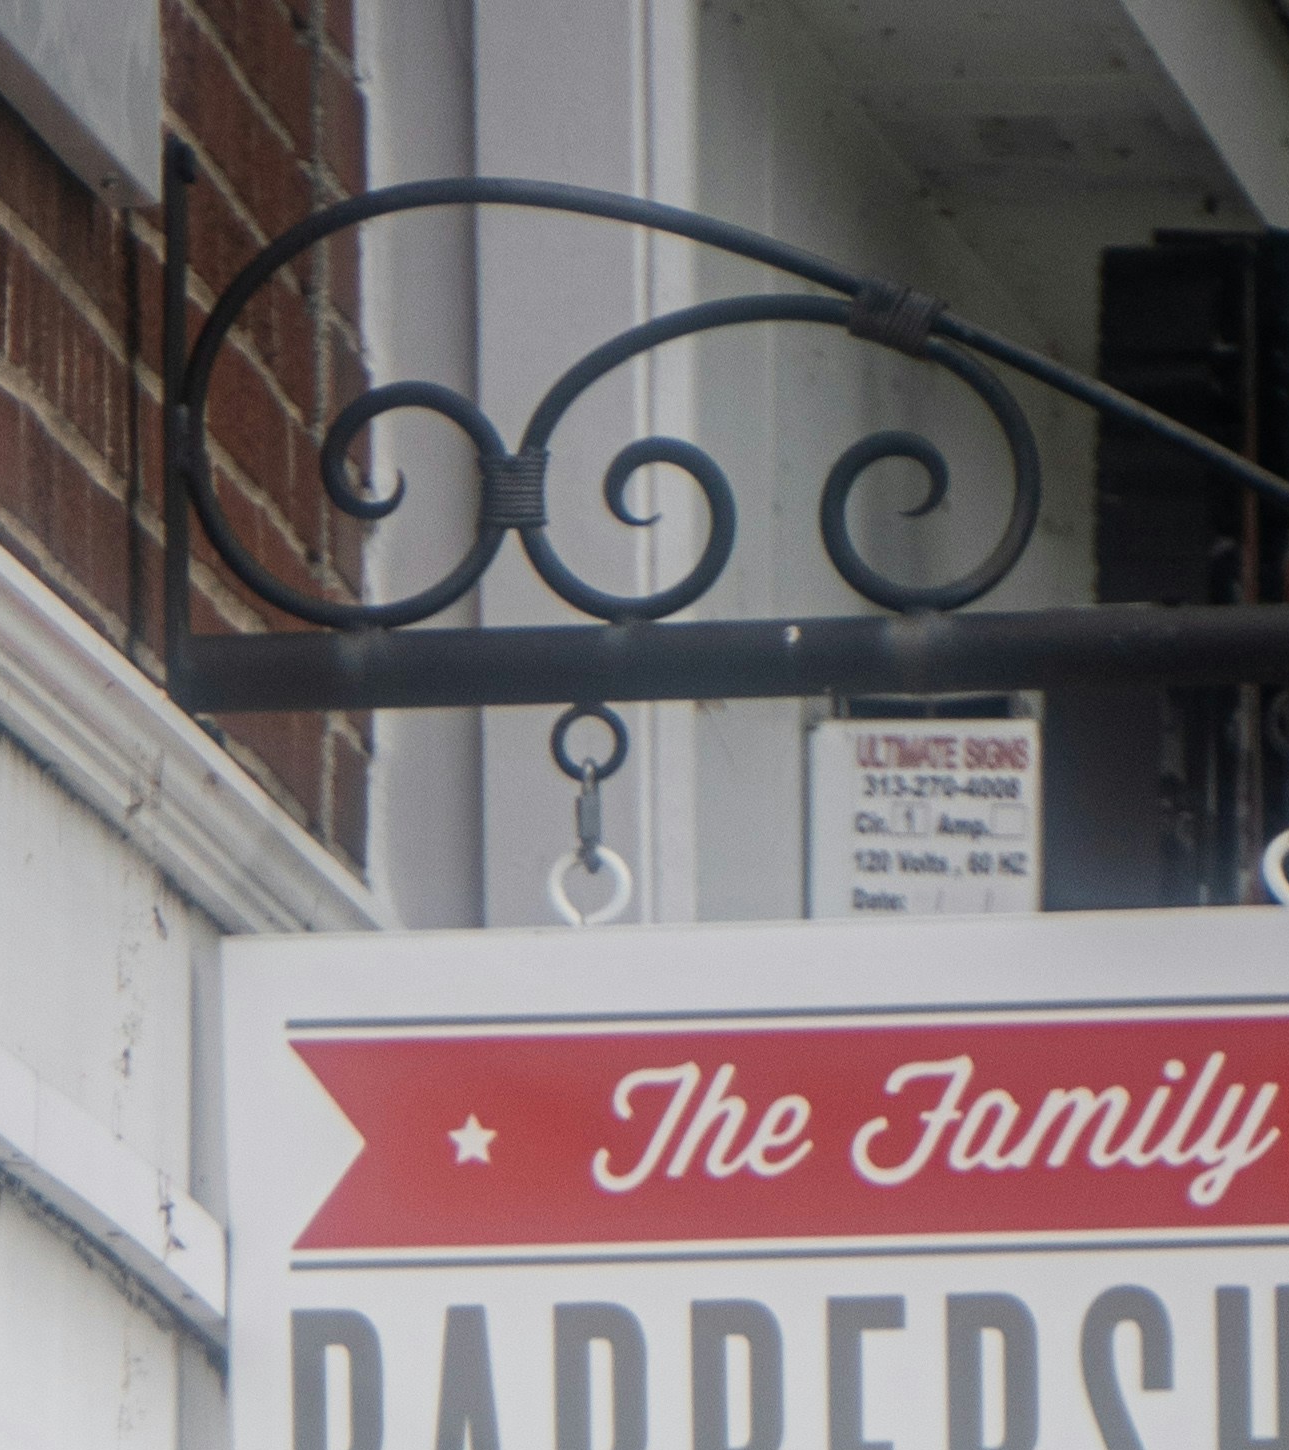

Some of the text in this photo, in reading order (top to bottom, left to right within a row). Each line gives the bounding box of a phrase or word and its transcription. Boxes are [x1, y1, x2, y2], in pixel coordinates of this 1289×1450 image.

[964, 736, 1029, 770] SIGNS
[593, 1052, 1279, 1205] The Family
